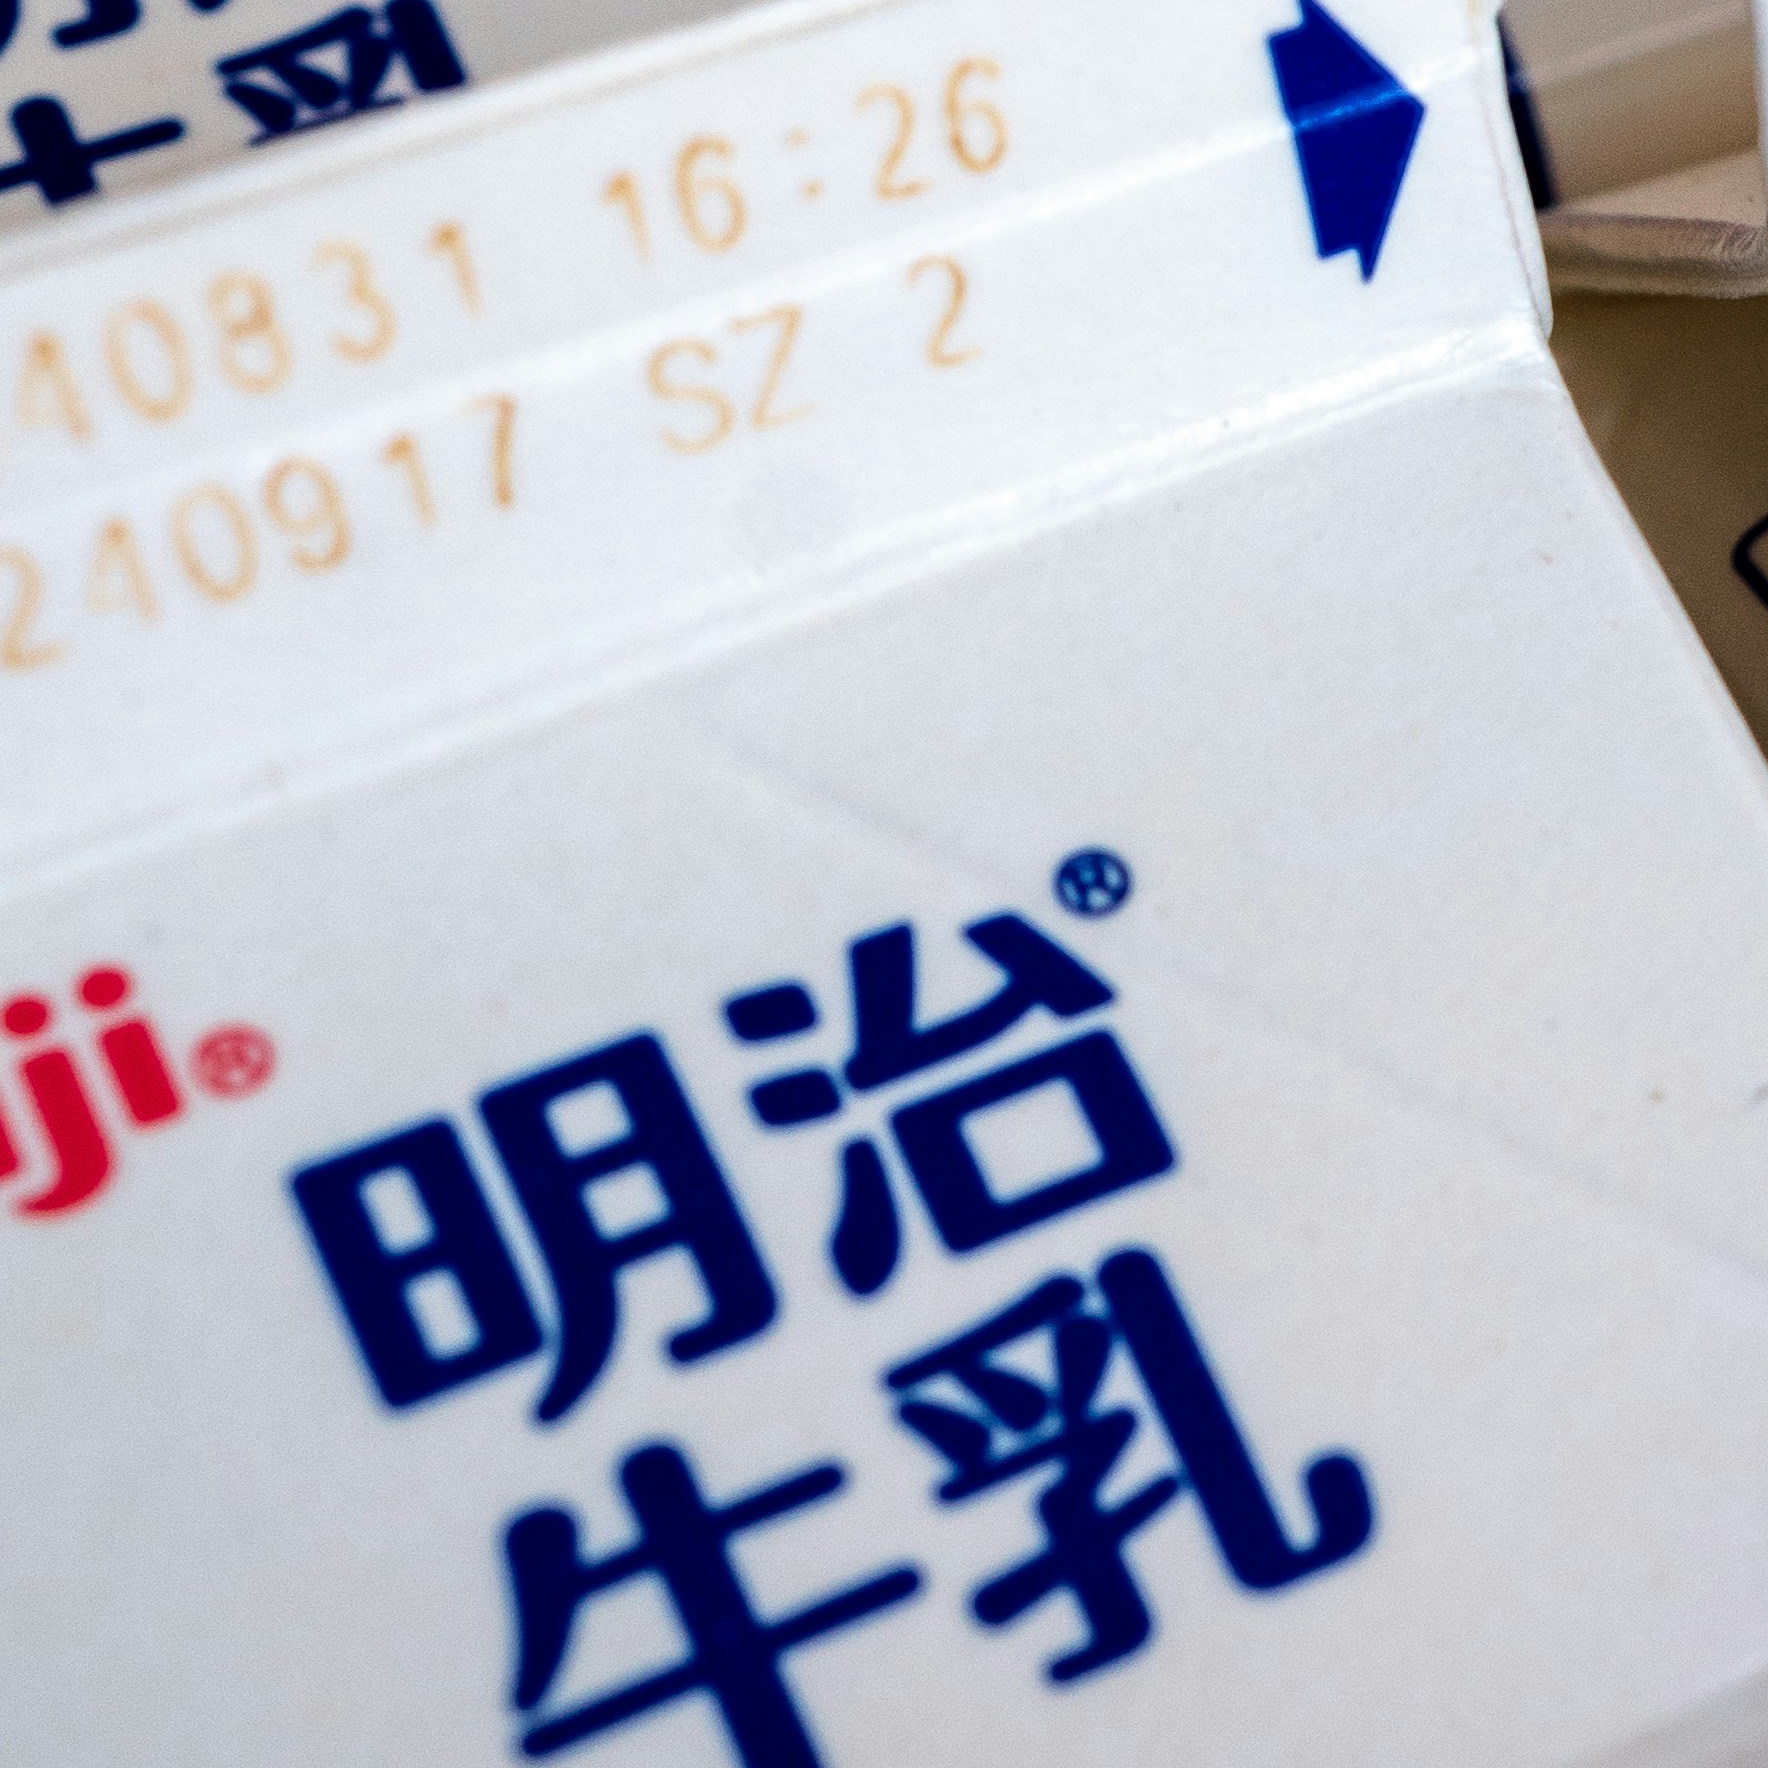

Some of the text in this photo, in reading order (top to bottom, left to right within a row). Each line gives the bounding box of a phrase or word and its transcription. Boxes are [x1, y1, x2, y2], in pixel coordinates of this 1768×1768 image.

[602, 55, 1009, 264] 16:26
[643, 300, 817, 456] SZ
[905, 251, 983, 369] 2
